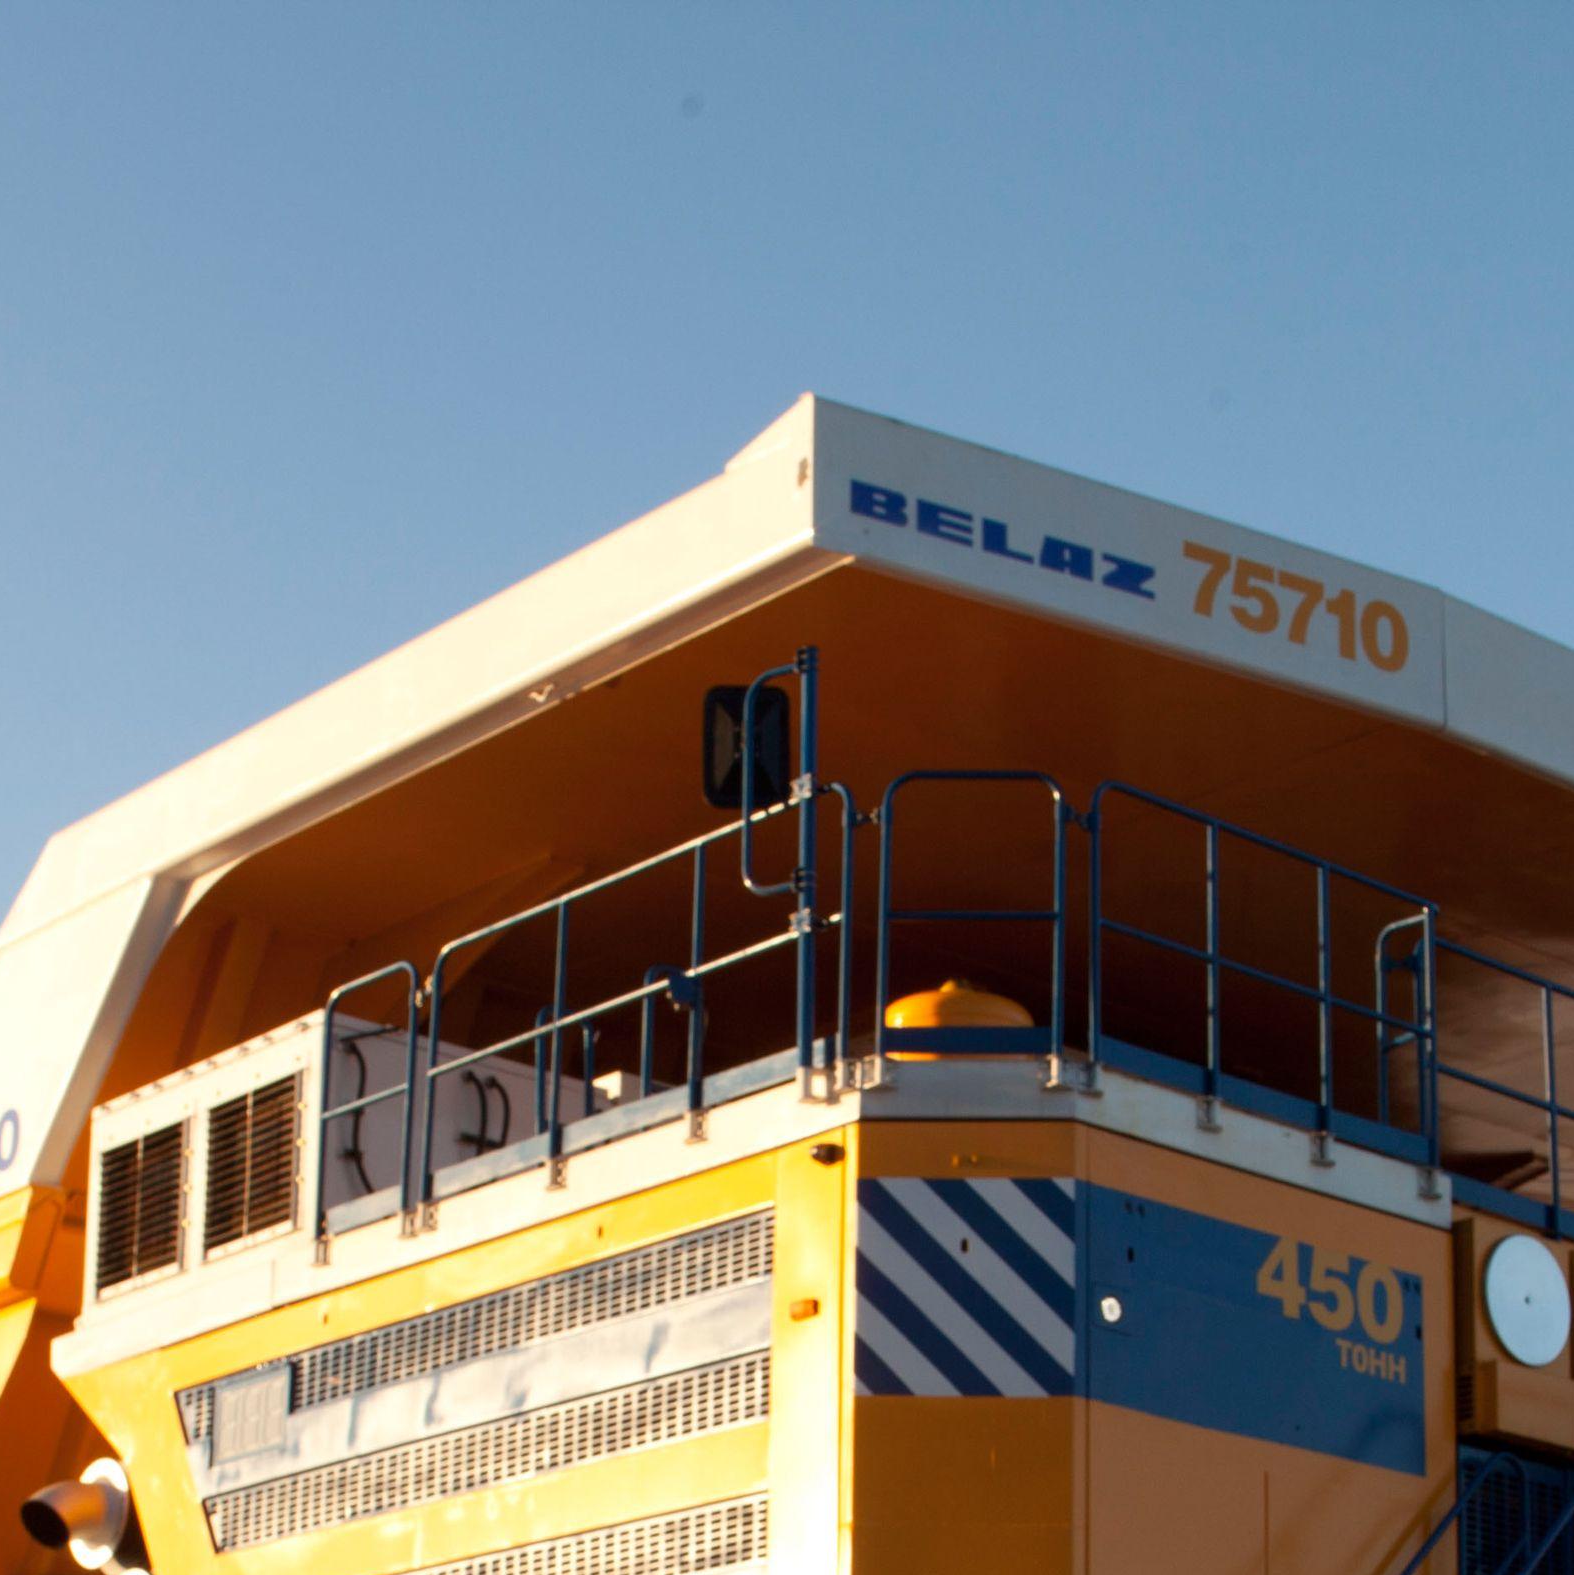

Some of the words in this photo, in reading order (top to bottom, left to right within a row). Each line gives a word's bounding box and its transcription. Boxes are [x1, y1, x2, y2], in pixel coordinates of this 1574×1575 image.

[850, 479, 1156, 600] BELAZ
[1183, 540, 1409, 672] 75710
[1257, 1236, 1404, 1344] 450
[1336, 1338, 1406, 1384] ТОНН
